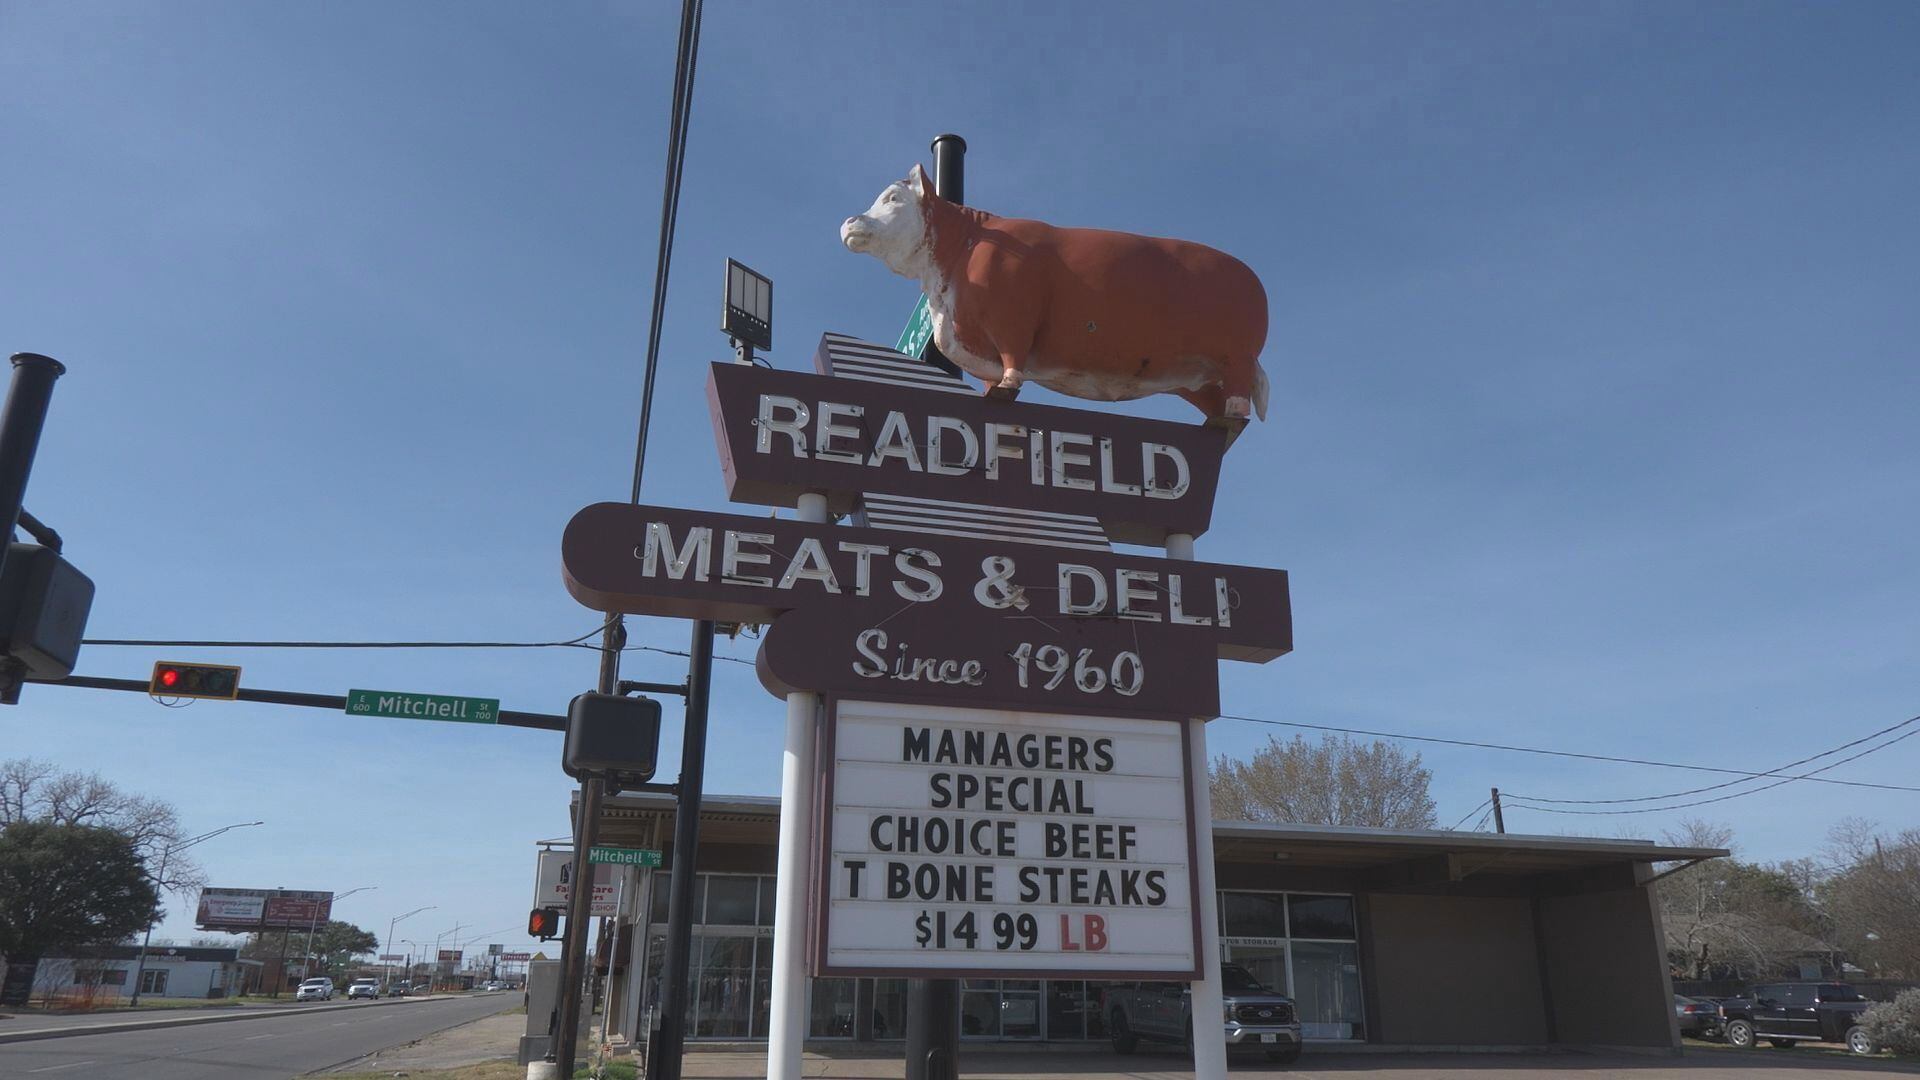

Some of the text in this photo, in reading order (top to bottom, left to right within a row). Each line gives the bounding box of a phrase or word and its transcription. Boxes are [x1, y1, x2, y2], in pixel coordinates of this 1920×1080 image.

[756, 394, 1191, 500] READFIELD
[641, 521, 1231, 628] MEATS & DELI
[852, 629, 1145, 696] Since 1960
[353, 704, 370, 712] 600
[378, 696, 467, 718] Mitchell
[475, 711, 491, 720] 700
[480, 703, 488, 711] St
[903, 727, 1114, 772] MANAGERS
[930, 773, 1094, 814] SPECIAL
[589, 849, 642, 863] Mitchell
[870, 815, 1136, 860] CHOICE BEEF
[844, 861, 1167, 906] T BONE STEAKS
[1060, 914, 1108, 951] LB
